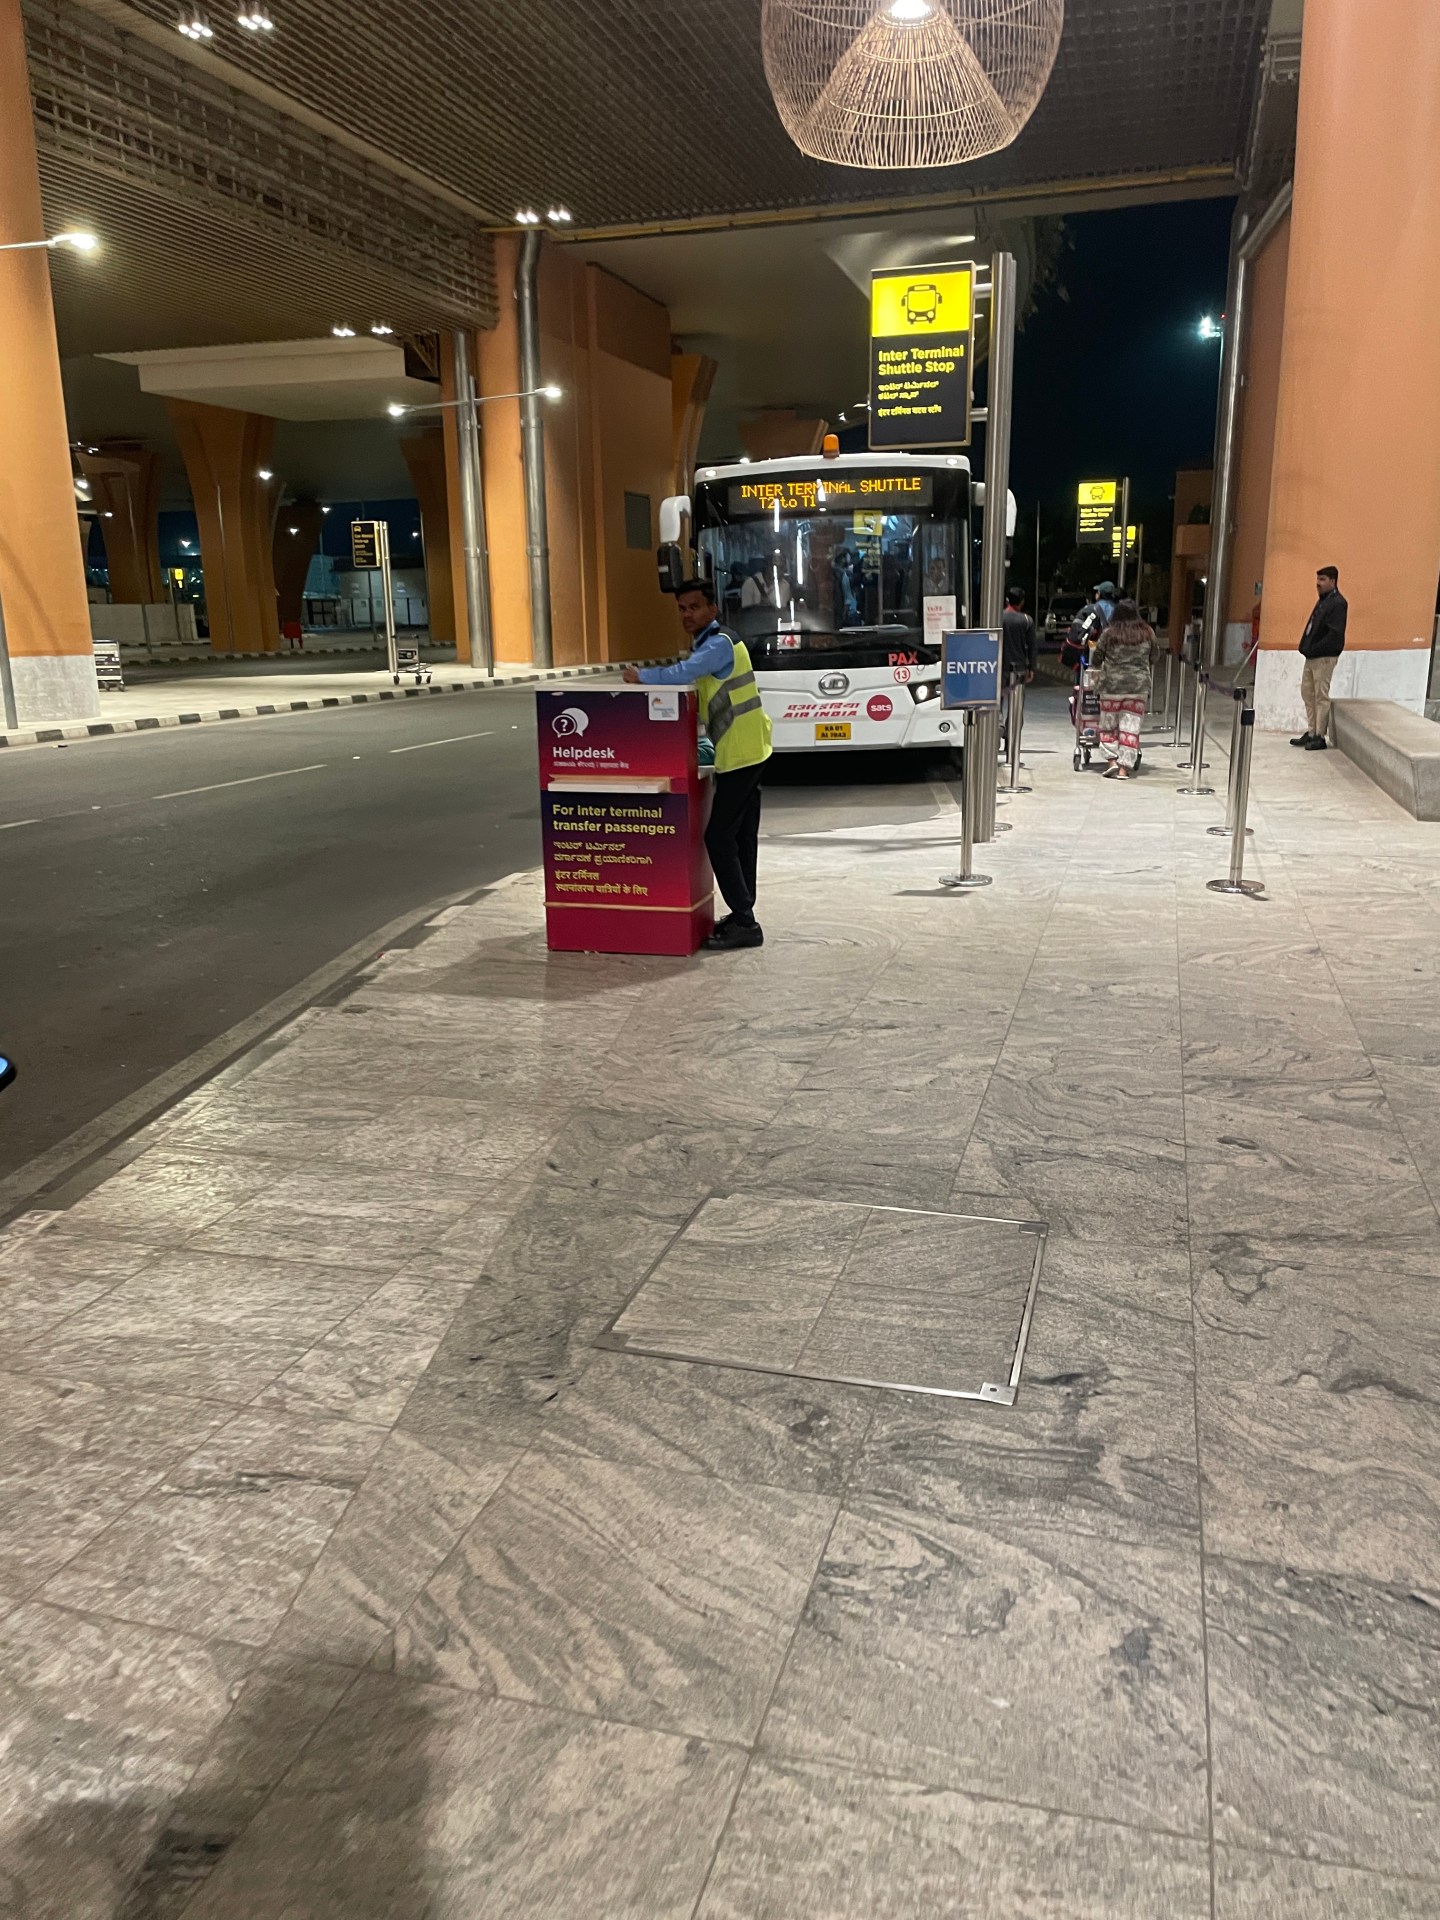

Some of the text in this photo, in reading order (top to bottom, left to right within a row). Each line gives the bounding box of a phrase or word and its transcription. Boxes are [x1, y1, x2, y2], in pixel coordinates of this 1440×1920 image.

[878, 344, 964, 362] Inter Terminal
[878, 361, 955, 376] Shuttle Stop
[741, 484, 783, 498] INTER
[860, 478, 921, 492] SHUTTLE
[759, 495, 816, 509] T2 to T1
[888, 651, 919, 666] PAX
[895, 669, 908, 680] 13
[946, 661, 997, 674] ENTRY
[870, 704, 892, 712] sats
[553, 746, 615, 760] Helpdesk
[552, 804, 663, 818] For inter terminal
[553, 820, 676, 835] transfer passengers
